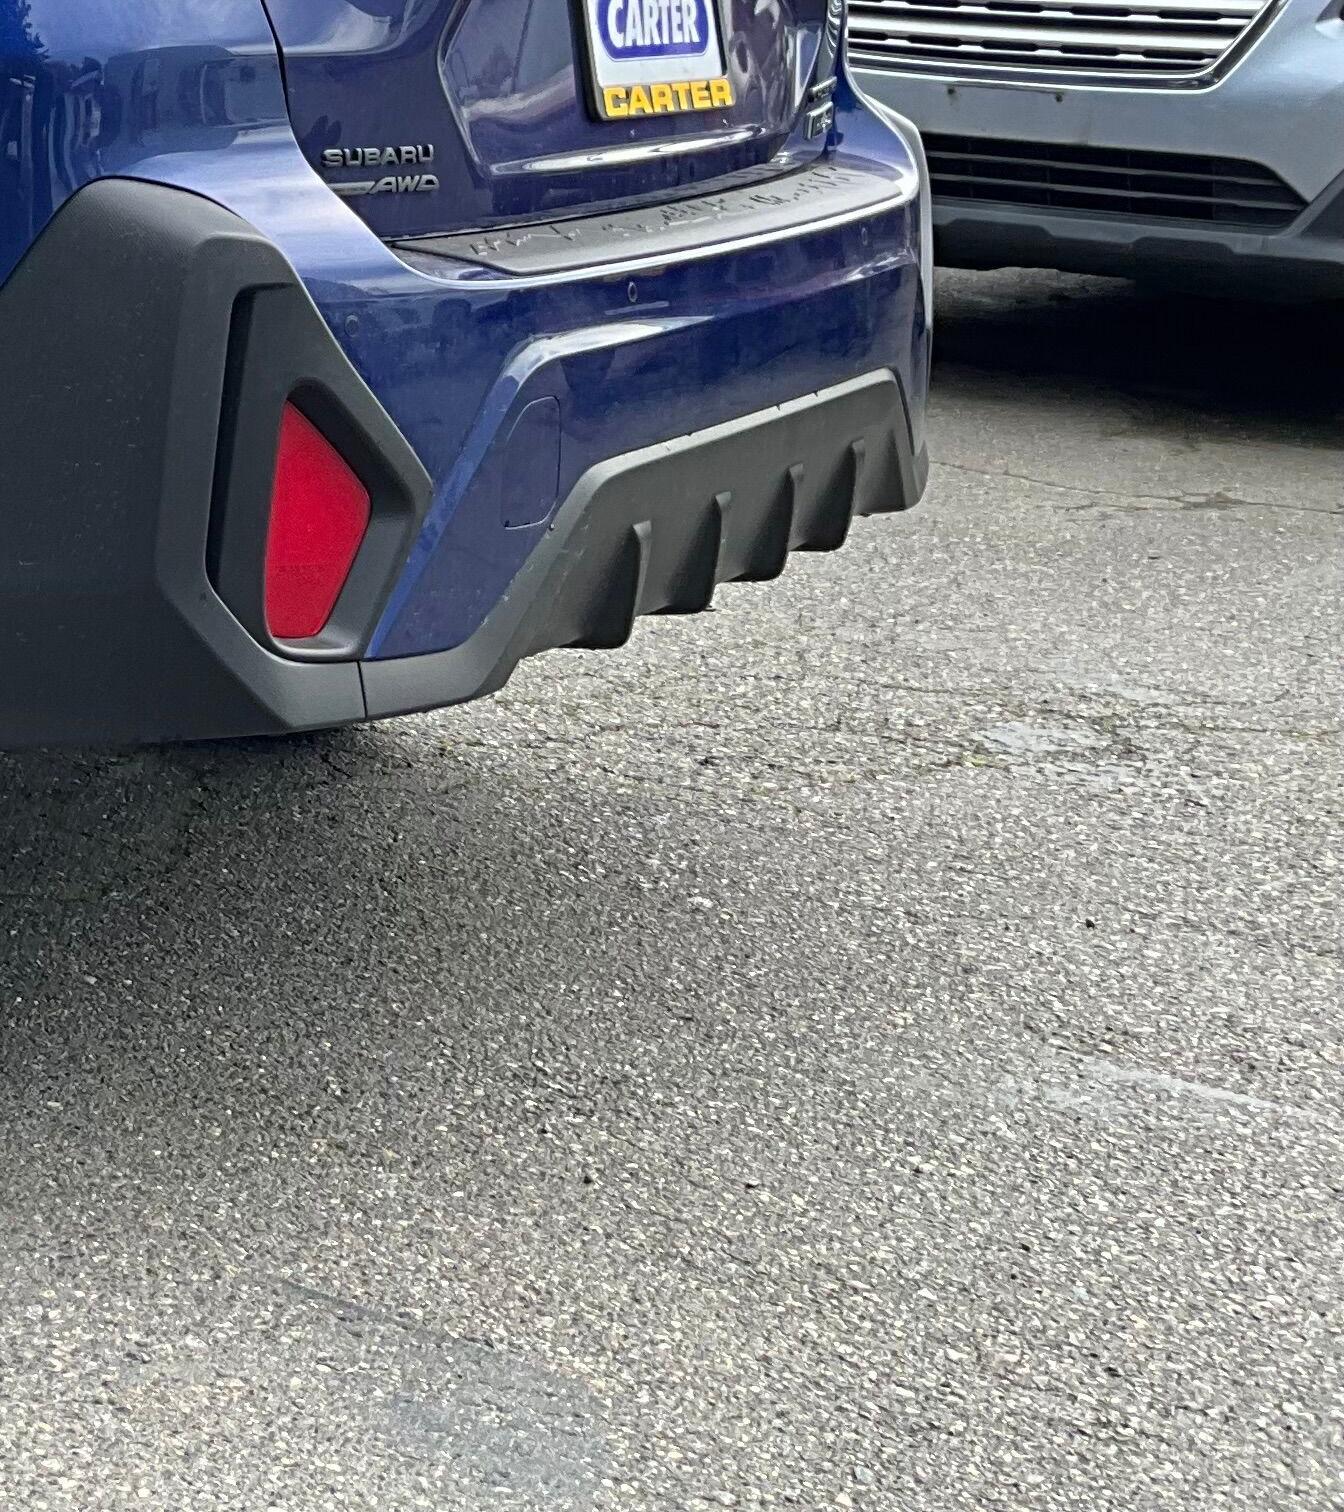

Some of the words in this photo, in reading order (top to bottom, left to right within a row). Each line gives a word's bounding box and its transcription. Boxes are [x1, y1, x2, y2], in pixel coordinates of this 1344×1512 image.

[603, 78, 733, 117] CARTER
[321, 144, 434, 167] SUBARU
[369, 174, 440, 194] AWD
